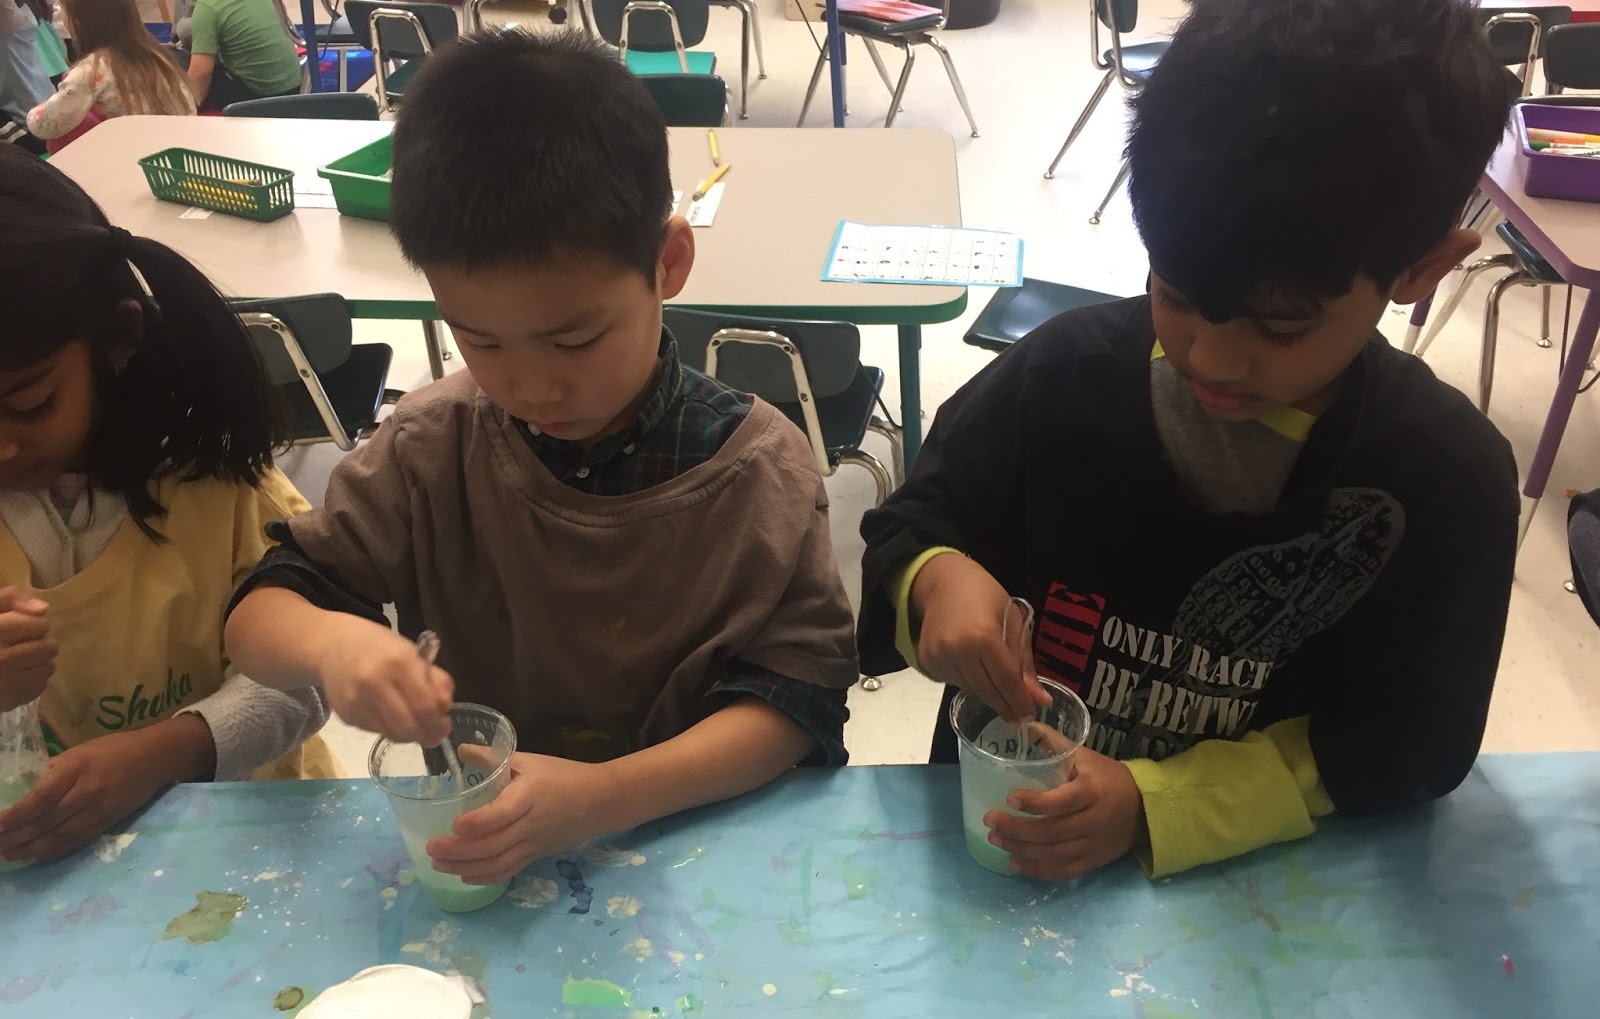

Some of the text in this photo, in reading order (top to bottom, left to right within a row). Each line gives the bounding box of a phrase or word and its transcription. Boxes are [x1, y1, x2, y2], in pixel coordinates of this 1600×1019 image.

[1102, 616, 1183, 668] ONLY
[1086, 659, 1260, 737] BE BETW
